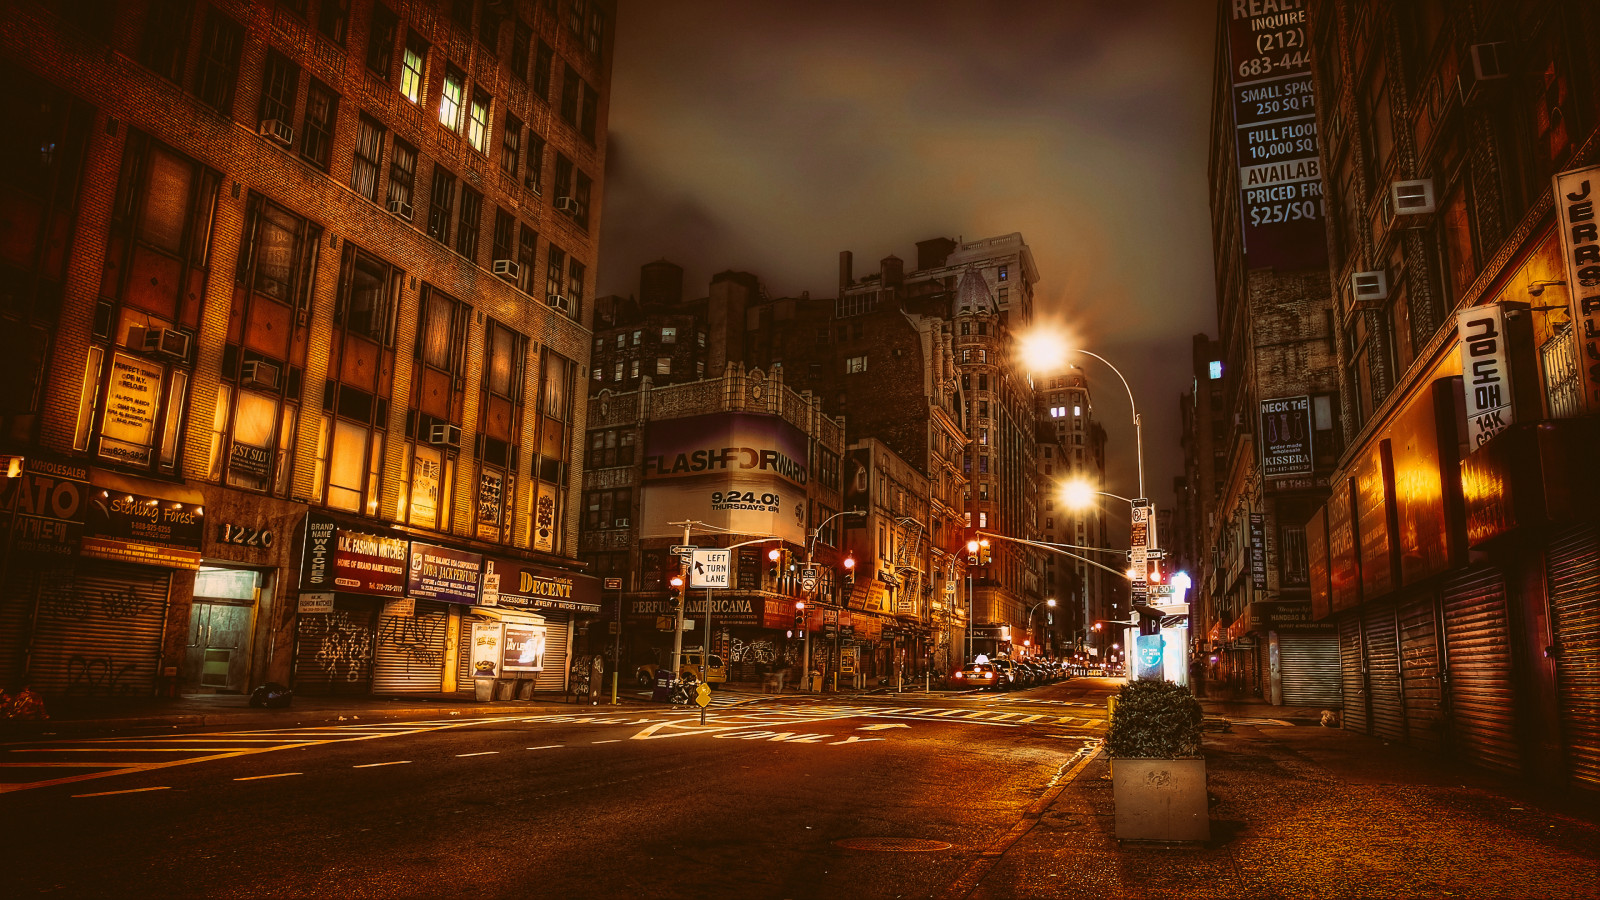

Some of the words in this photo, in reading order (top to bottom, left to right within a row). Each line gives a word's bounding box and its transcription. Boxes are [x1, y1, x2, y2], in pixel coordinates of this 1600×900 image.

[1251, 10, 1306, 31] INQUIRE
[1256, 28, 1305, 55] (212)
[1241, 85, 1283, 104] SMALL
[1256, 101, 1280, 117] 250
[1282, 97, 1300, 113] SQ
[1248, 129, 1279, 145] FULL
[1249, 140, 1294, 159] 10,000
[1296, 138, 1313, 153] SQ
[1246, 185, 1297, 206] PRICED
[1249, 199, 1316, 227] $25/SQ
[114, 361, 140, 374] PERFECT
[140, 369, 160, 380] TIMING
[122, 381, 148, 392] RELOJES
[136, 376, 147, 384] N.Y.
[1261, 402, 1289, 414] NECK
[1475, 410, 1506, 432] 14K
[1264, 453, 1310, 466] KISSERA
[1272, 447, 1301, 455] wholesale
[31, 458, 87, 480] WHOLESALER
[712, 490, 780, 507] 9.24.09
[110, 499, 160, 524] Sterling
[163, 508, 196, 525] Forest
[712, 503, 766, 512] THURSDAYS
[224, 523, 273, 548] 1220
[311, 523, 335, 531] BRAND
[311, 530, 332, 538] NAME
[352, 538, 379, 557] FASHION
[378, 542, 405, 561] WATCHES
[707, 554, 726, 562] LEFT
[309, 538, 329, 584] WATCHES
[337, 558, 351, 567] HOME
[351, 560, 357, 568] OF
[357, 561, 372, 571] BRAND
[383, 565, 403, 575] WATCHES
[706, 564, 726, 573] TURN
[453, 568, 478, 584] PERFUME
[705, 574, 726, 583] LANE
[500, 594, 529, 605] ACCESSORIES
[534, 599, 553, 608] JEWELRY
[558, 602, 576, 610] WATCHES
[685, 599, 753, 613] AMERICANA
